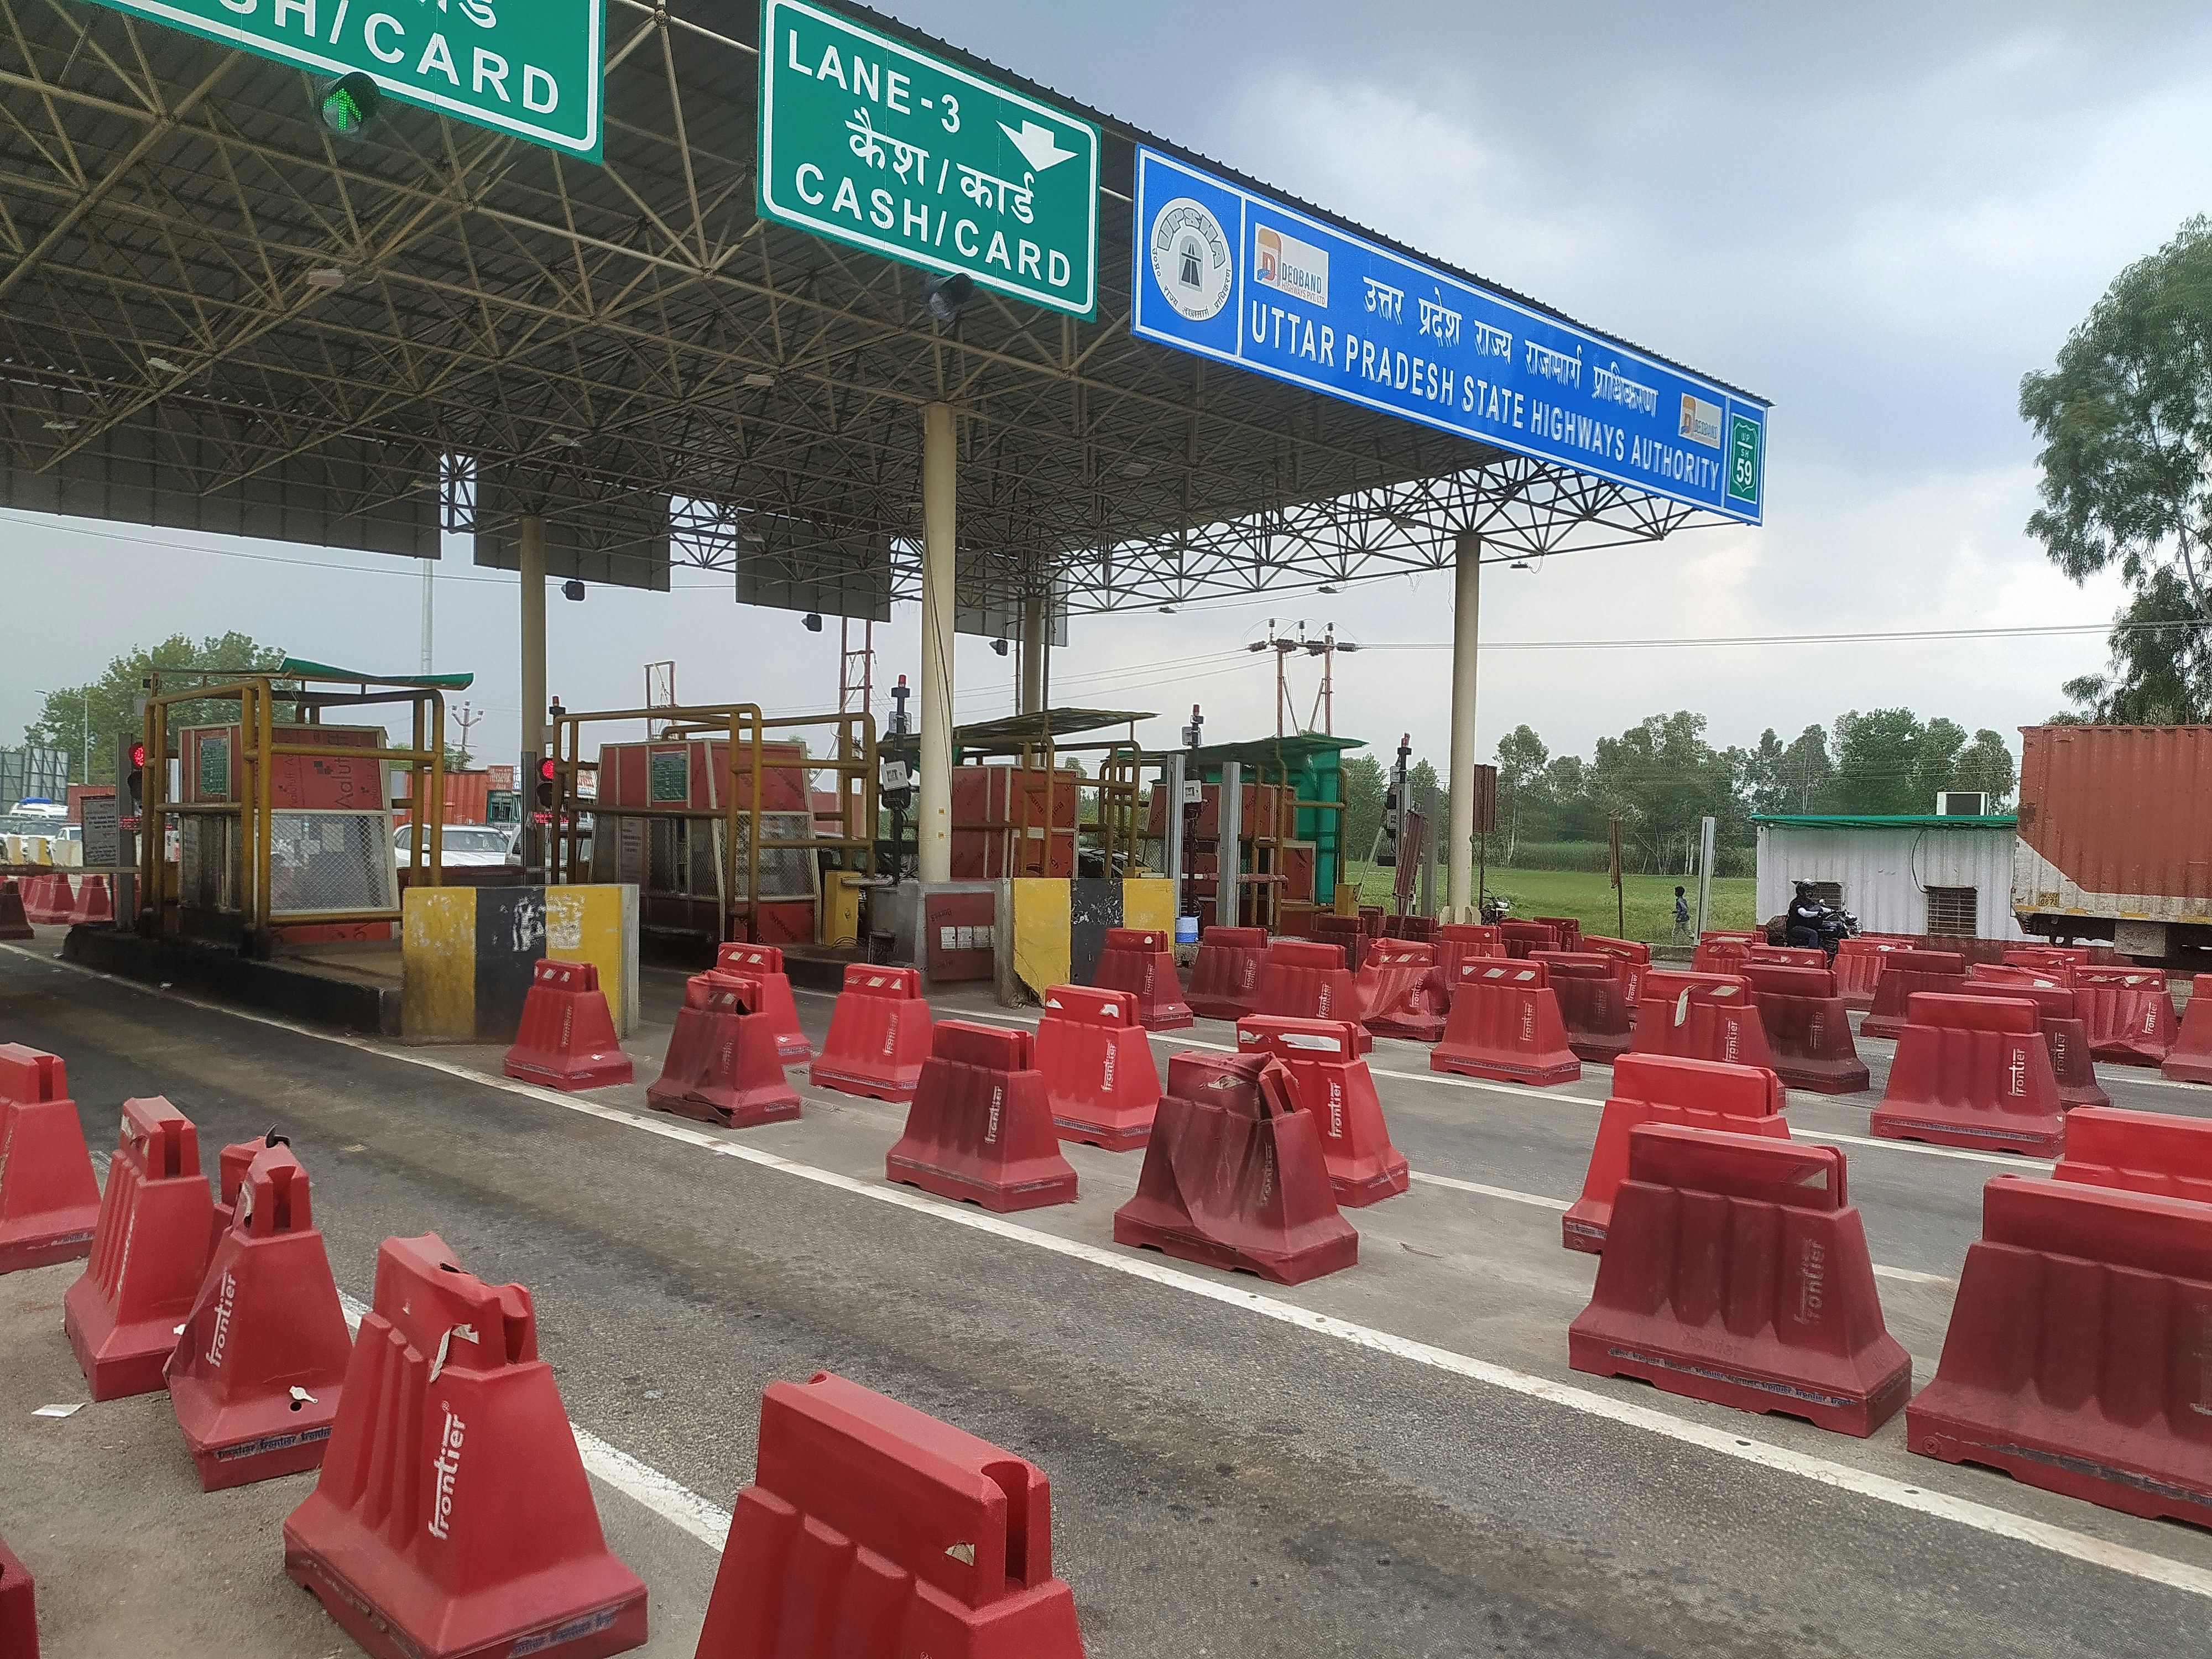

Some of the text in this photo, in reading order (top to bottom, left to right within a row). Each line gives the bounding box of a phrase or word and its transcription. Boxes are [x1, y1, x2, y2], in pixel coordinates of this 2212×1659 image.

[795, 163, 1071, 287] CASH/CARD
[1157, 207, 1226, 269] UPSHA
[1281, 281, 1306, 299] HIGHWAYS
[1282, 262, 1322, 294] DEOBAND
[1362, 276, 1658, 419] उत्तर प्रदेश राज्य राजमार्ग प्राधिकरण
[1251, 300, 1720, 492] UTTAR PRADESH STATE HIGHWAYS AUTHORITY
[1694, 419, 1718, 440] DEOBAND
[1736, 458, 1752, 486] 59
[1143, 962, 1154, 996] frontier
[1242, 958, 1256, 990] frontier
[1410, 977, 1425, 1008] frontier
[1626, 973, 1639, 1002] frontier
[1317, 982, 1332, 1019] frontier
[1520, 1000, 1533, 1042] frontier
[2142, 1001, 2157, 1035] frontier
[883, 1013, 898, 1056] frontier
[1723, 1019, 1739, 1062] frontier
[1102, 1040, 1117, 1093] frontier
[2008, 1048, 2026, 1097] frontier
[985, 1084, 1003, 1144] frontier
[1328, 1079, 1342, 1139] frontier
[1794, 1238, 1826, 1326] frontier
[206, 1272, 237, 1368] frontier
[429, 1413, 466, 1540] frontier
